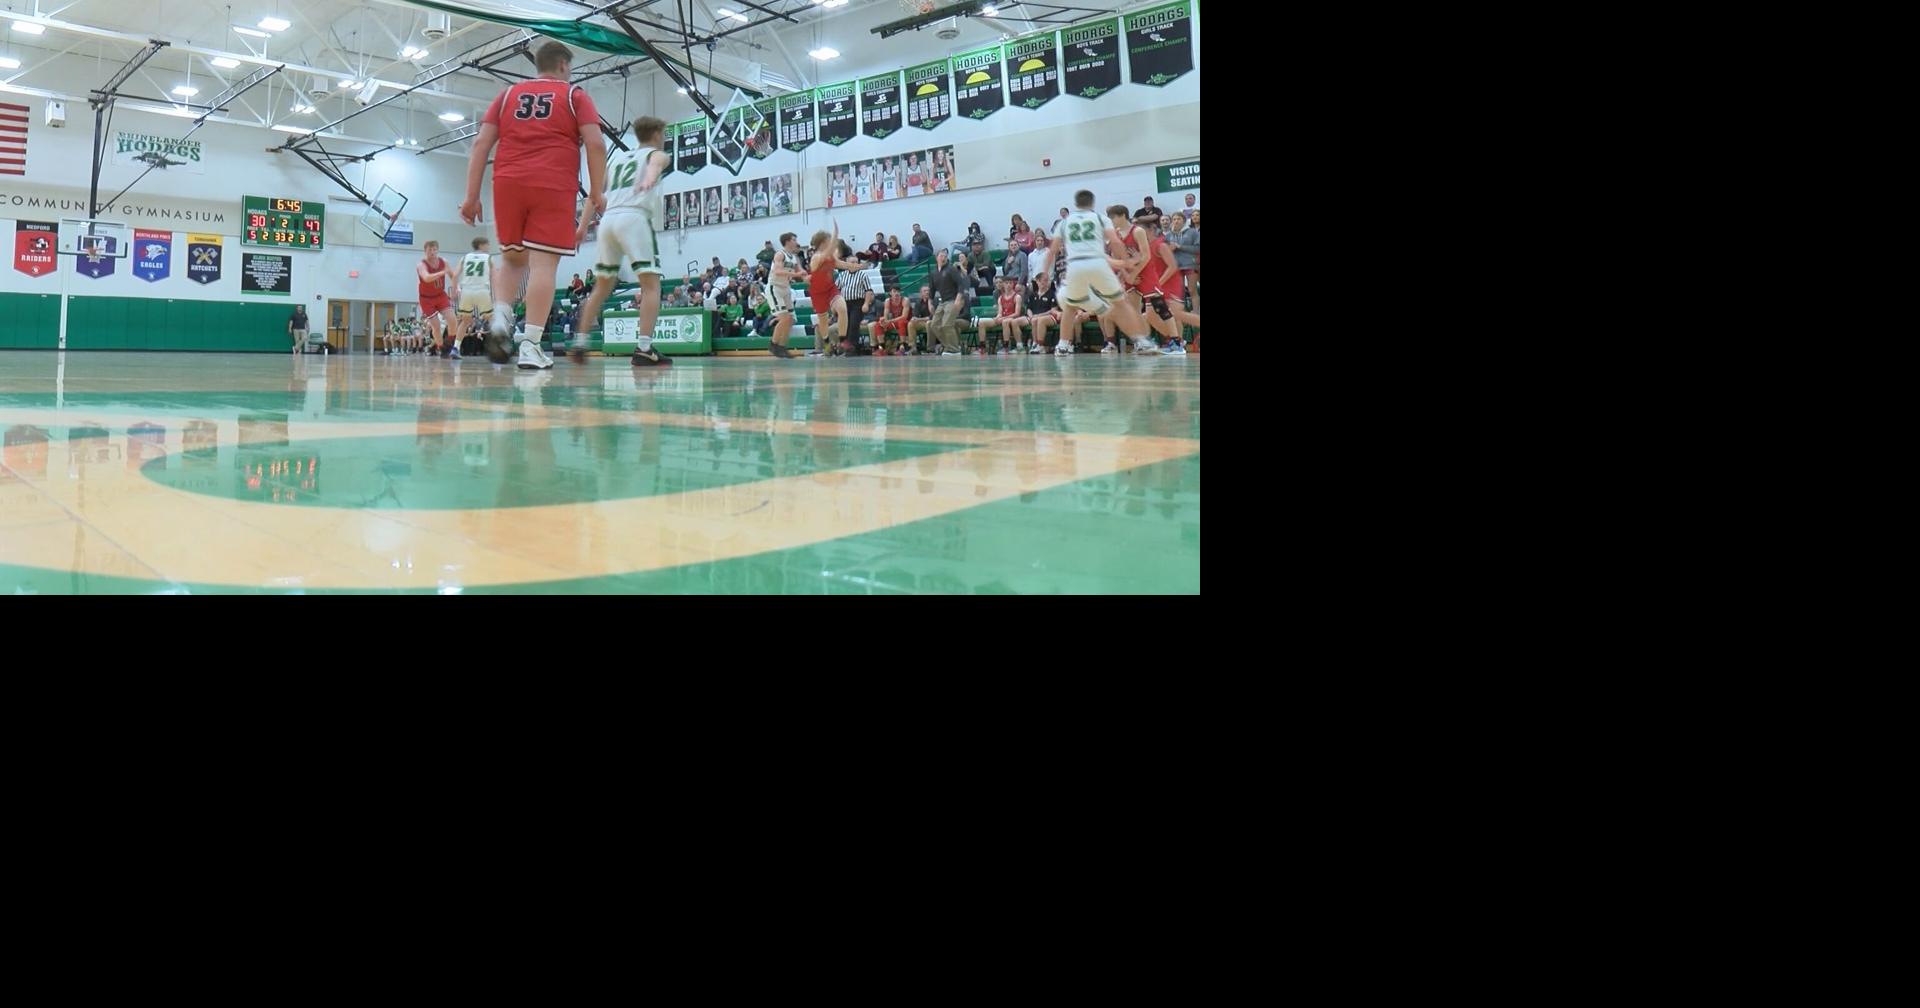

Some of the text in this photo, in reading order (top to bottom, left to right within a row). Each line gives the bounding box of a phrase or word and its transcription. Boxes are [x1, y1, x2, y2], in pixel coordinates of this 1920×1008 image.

[1130, 7, 1184, 30] HODAGS
[1066, 24, 1113, 43] HODAGS
[1141, 22, 1174, 35] GIRLS TRACK
[1010, 38, 1052, 57] HODAGS
[1089, 38, 1104, 46] TRACK
[1131, 37, 1188, 54] CONFERENCE CHAMPS
[957, 52, 997, 69] HODAGS
[909, 64, 945, 81] HODAGS
[863, 76, 897, 92] HODAGS
[820, 86, 853, 100] HODAGS
[514, 92, 555, 120] 35
[782, 94, 812, 108] HODAGS
[118, 131, 201, 148] RHINELANDER
[116, 138, 201, 162] HODAGS
[610, 160, 638, 191] 12
[1169, 164, 1200, 177] VISITO
[0, 194, 225, 223] COMMUNTY GYMNASIUM
[277, 199, 301, 212] 6:45
[252, 215, 266, 227] 30
[281, 219, 288, 228] 2
[306, 220, 320, 232] 47
[250, 230, 257, 240] 5
[262, 231, 269, 241] 2
[1068, 220, 1095, 242] 22
[299, 234, 306, 244] 3
[313, 235, 320, 245] 5
[21, 254, 52, 263] RAIDERS
[140, 261, 164, 269] EAGLES
[190, 264, 218, 272] HATCHETS
[465, 260, 485, 277] 24
[664, 318, 677, 327] THE
